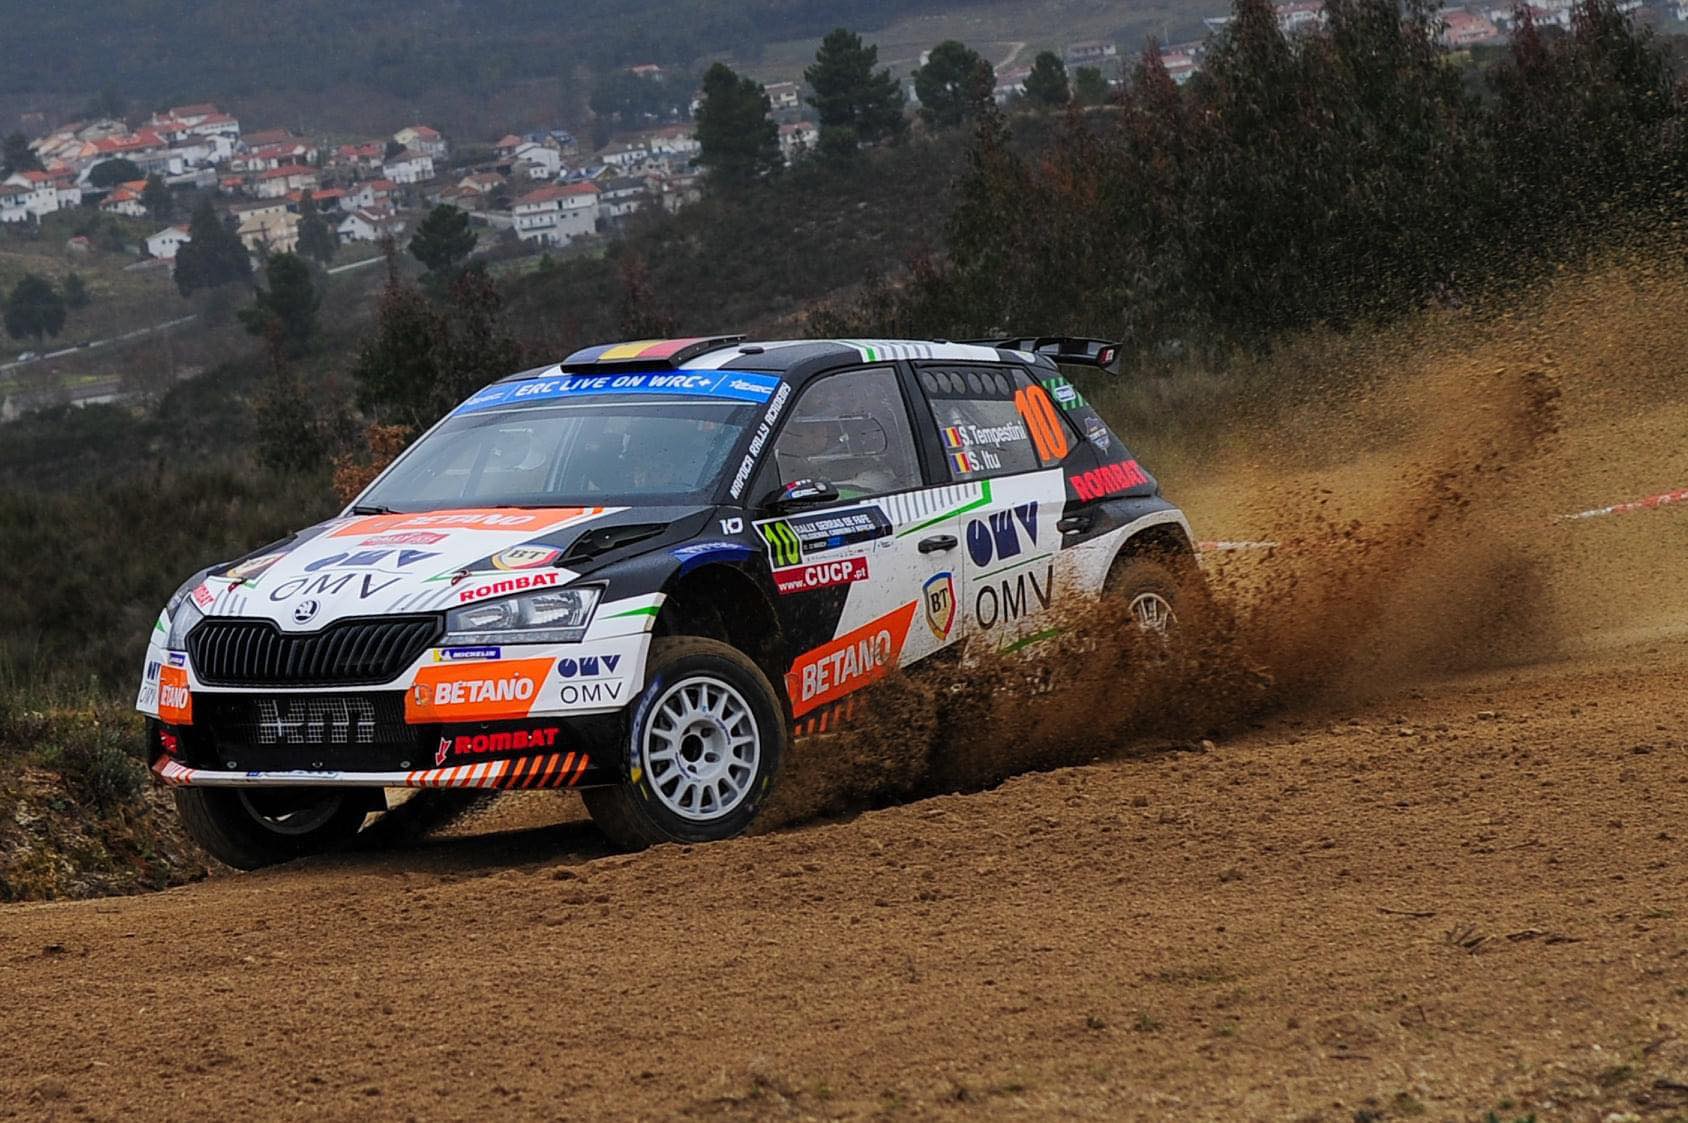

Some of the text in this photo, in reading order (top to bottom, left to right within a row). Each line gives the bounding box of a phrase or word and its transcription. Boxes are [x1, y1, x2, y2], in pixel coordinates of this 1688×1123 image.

[515, 375, 711, 397] ERC LIVE ON WRC+
[971, 422, 1026, 446] Tempestini
[1013, 385, 1069, 462] 10
[730, 381, 791, 500] NAPOCA RALLY ACADEMY
[969, 450, 1001, 472] S. Itu
[1070, 460, 1148, 500] ROMBAT
[720, 517, 744, 535] 10
[508, 549, 546, 561] BT
[764, 521, 799, 566] 10
[269, 573, 404, 601] OMV
[459, 572, 560, 603] ROMBAT
[777, 561, 866, 592] www.CUCP.pt
[930, 588, 948, 613] BT
[976, 564, 1053, 630] OMV
[802, 629, 891, 702] BETANO
[434, 677, 534, 705] BETANO
[560, 681, 623, 704] OMV
[453, 728, 559, 754] ROMBAT
